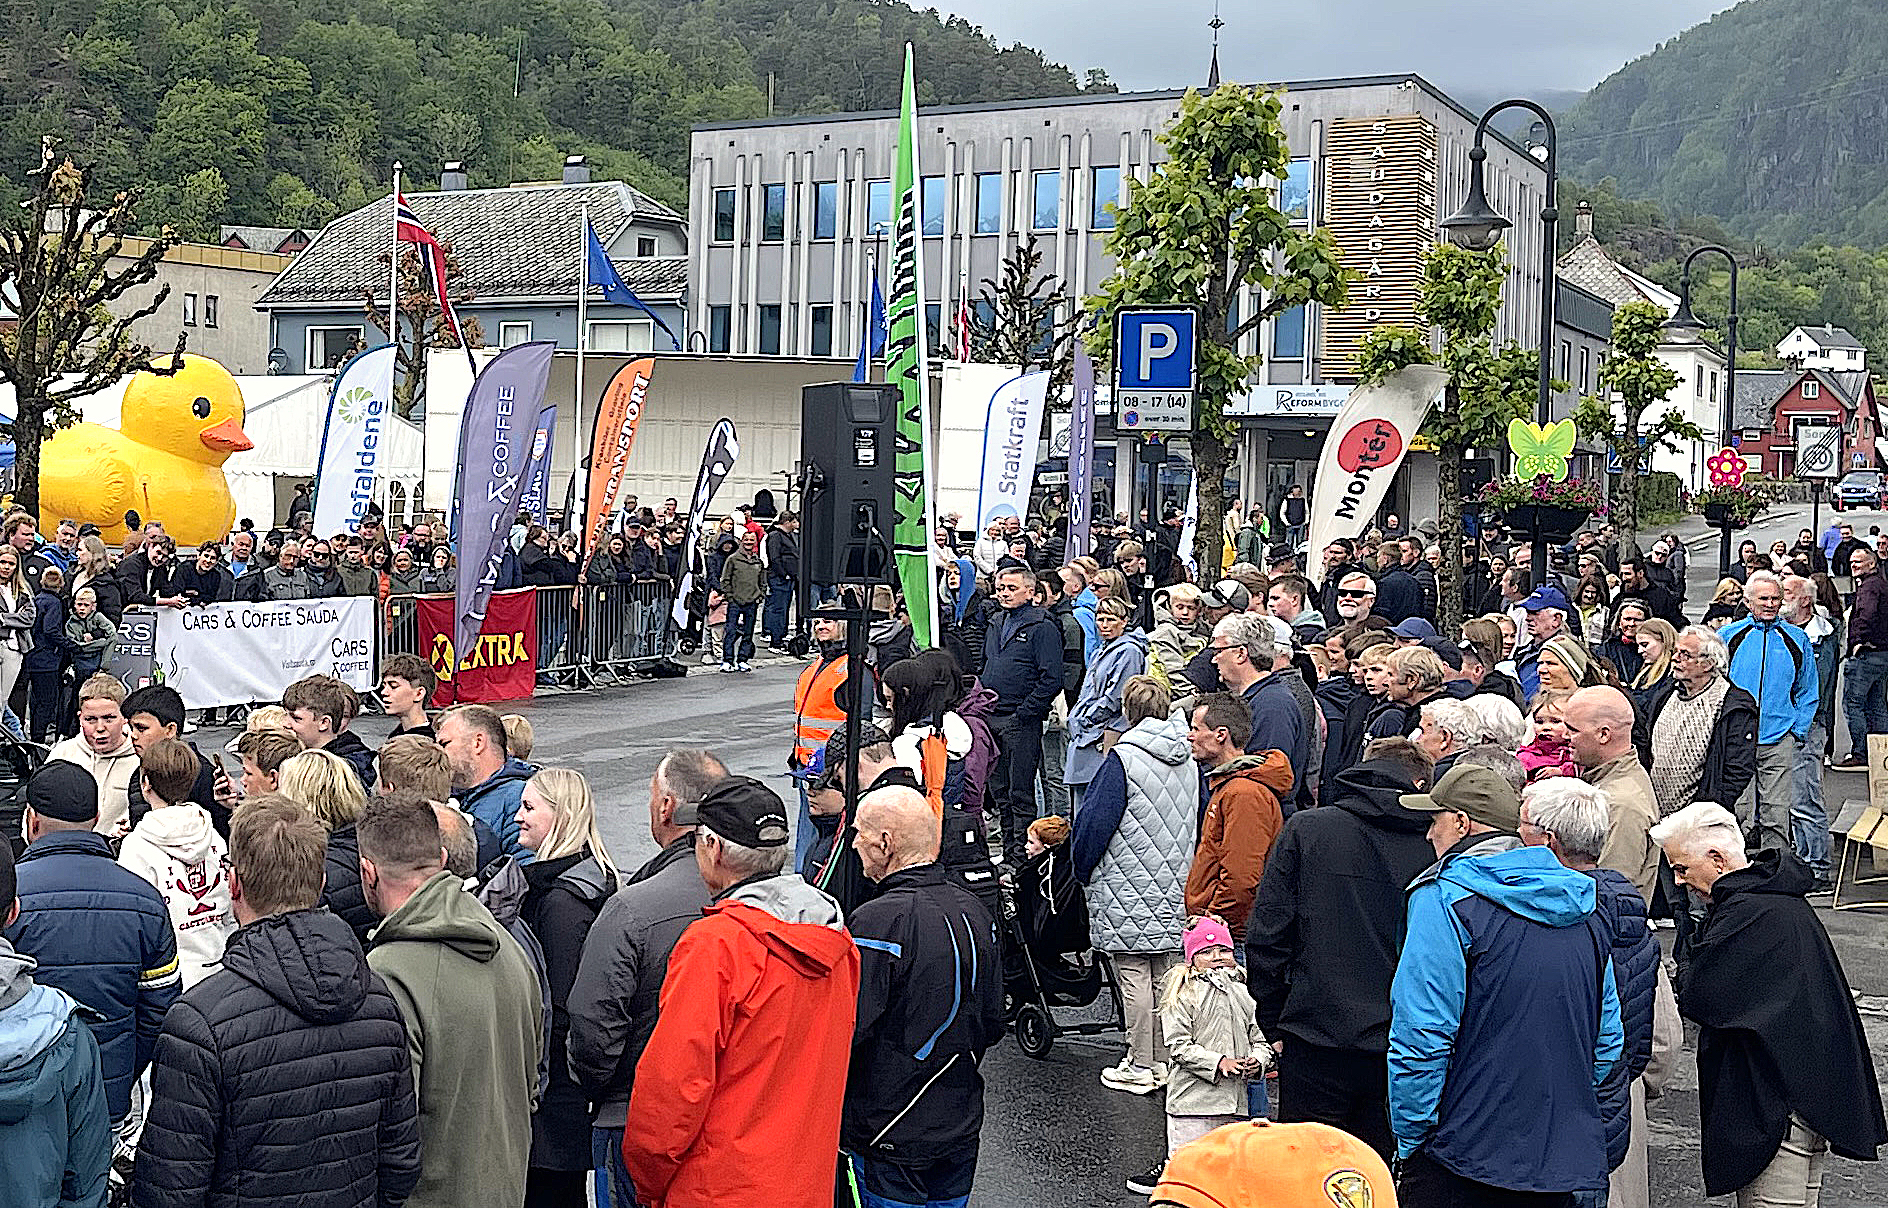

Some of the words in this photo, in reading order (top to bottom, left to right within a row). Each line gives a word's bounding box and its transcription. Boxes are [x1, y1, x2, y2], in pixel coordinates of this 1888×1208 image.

[1139, 323, 1178, 380] P
[1123, 396, 1139, 408] 08
[1151, 396, 1163, 408] 17
[1167, 393, 1187, 409] (14)
[492, 385, 515, 478] COFFEE
[603, 371, 651, 507] TRANSPORT
[998, 397, 1030, 496] Statkraft
[1334, 423, 1391, 520] Montér
[117, 622, 151, 641] RS
[225, 610, 237, 629] &
[331, 637, 368, 658] CARS
[340, 660, 369, 673] COFFEE
